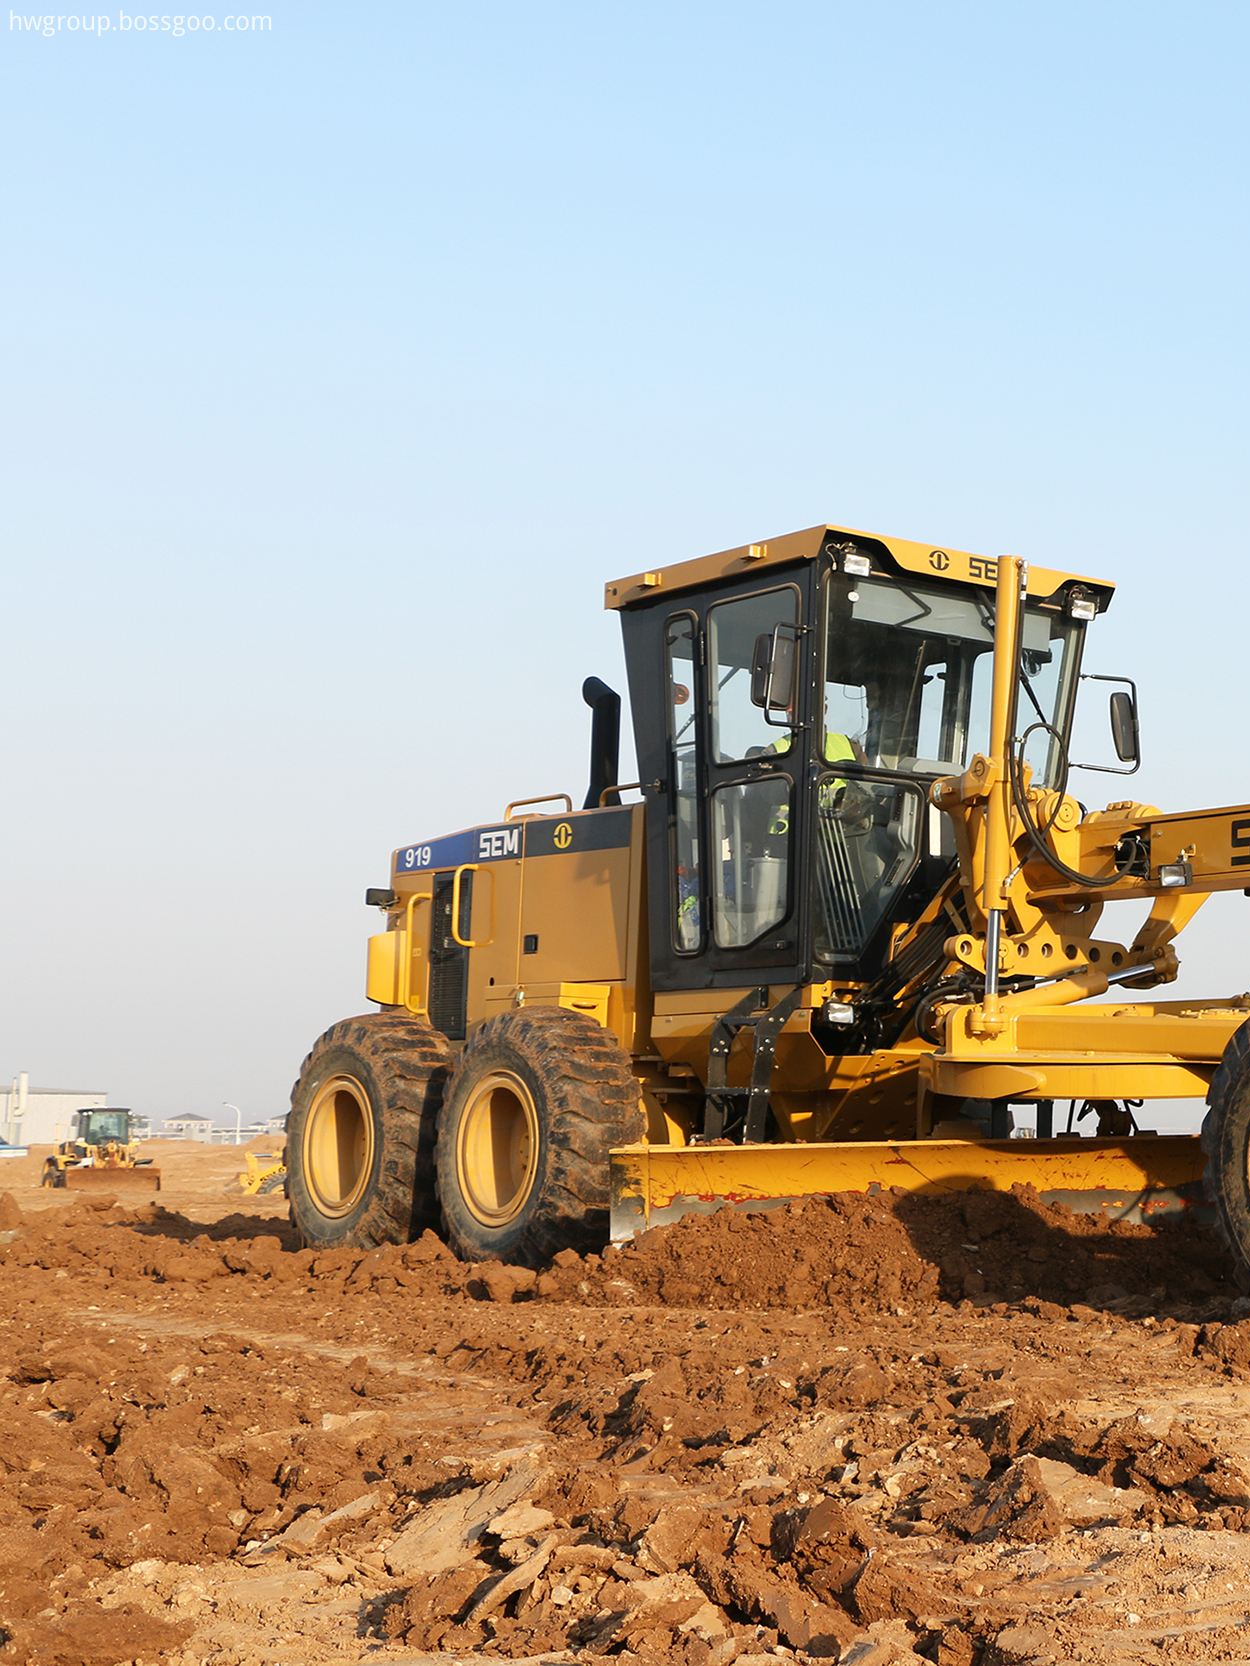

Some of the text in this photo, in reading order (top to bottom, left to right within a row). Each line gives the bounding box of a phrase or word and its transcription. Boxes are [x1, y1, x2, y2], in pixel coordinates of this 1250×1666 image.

[969, 556, 998, 581] SE
[479, 828, 519, 858] SEM
[405, 846, 431, 868] 919
